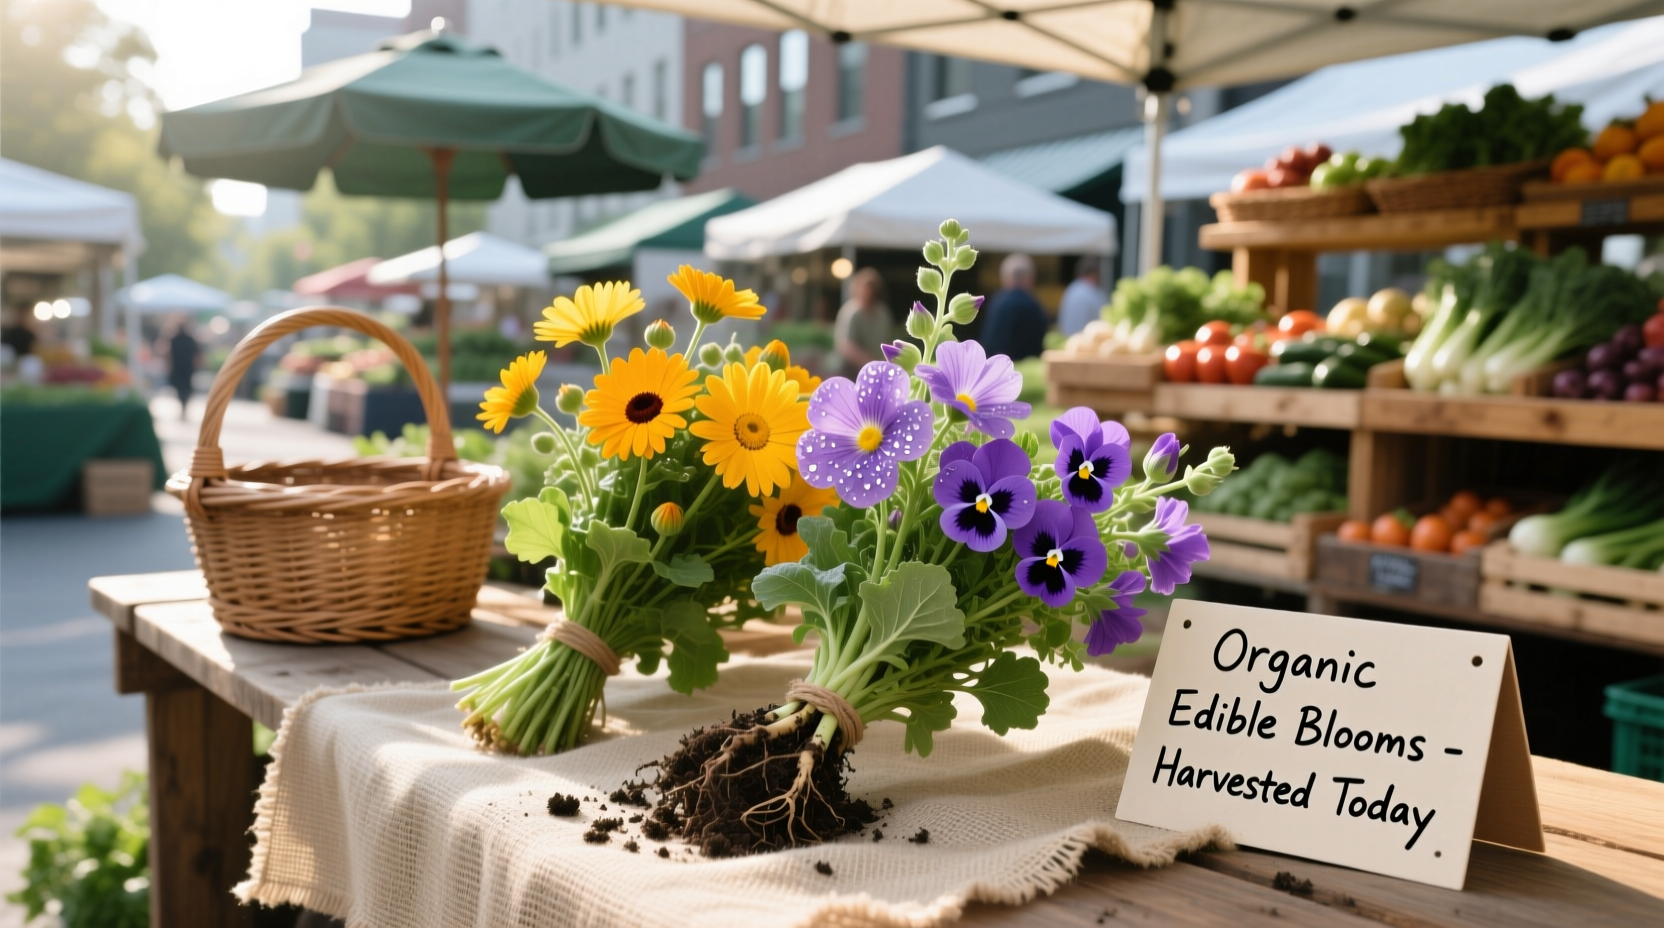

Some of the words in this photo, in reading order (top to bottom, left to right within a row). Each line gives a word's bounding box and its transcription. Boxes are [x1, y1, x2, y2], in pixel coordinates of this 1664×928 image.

[1213, 628, 1377, 693] Organic
[1168, 689, 1277, 739] Edible
[1294, 706, 1427, 761] Blooms
[1152, 745, 1317, 809] Harvested
[1332, 776, 1436, 851] Today
